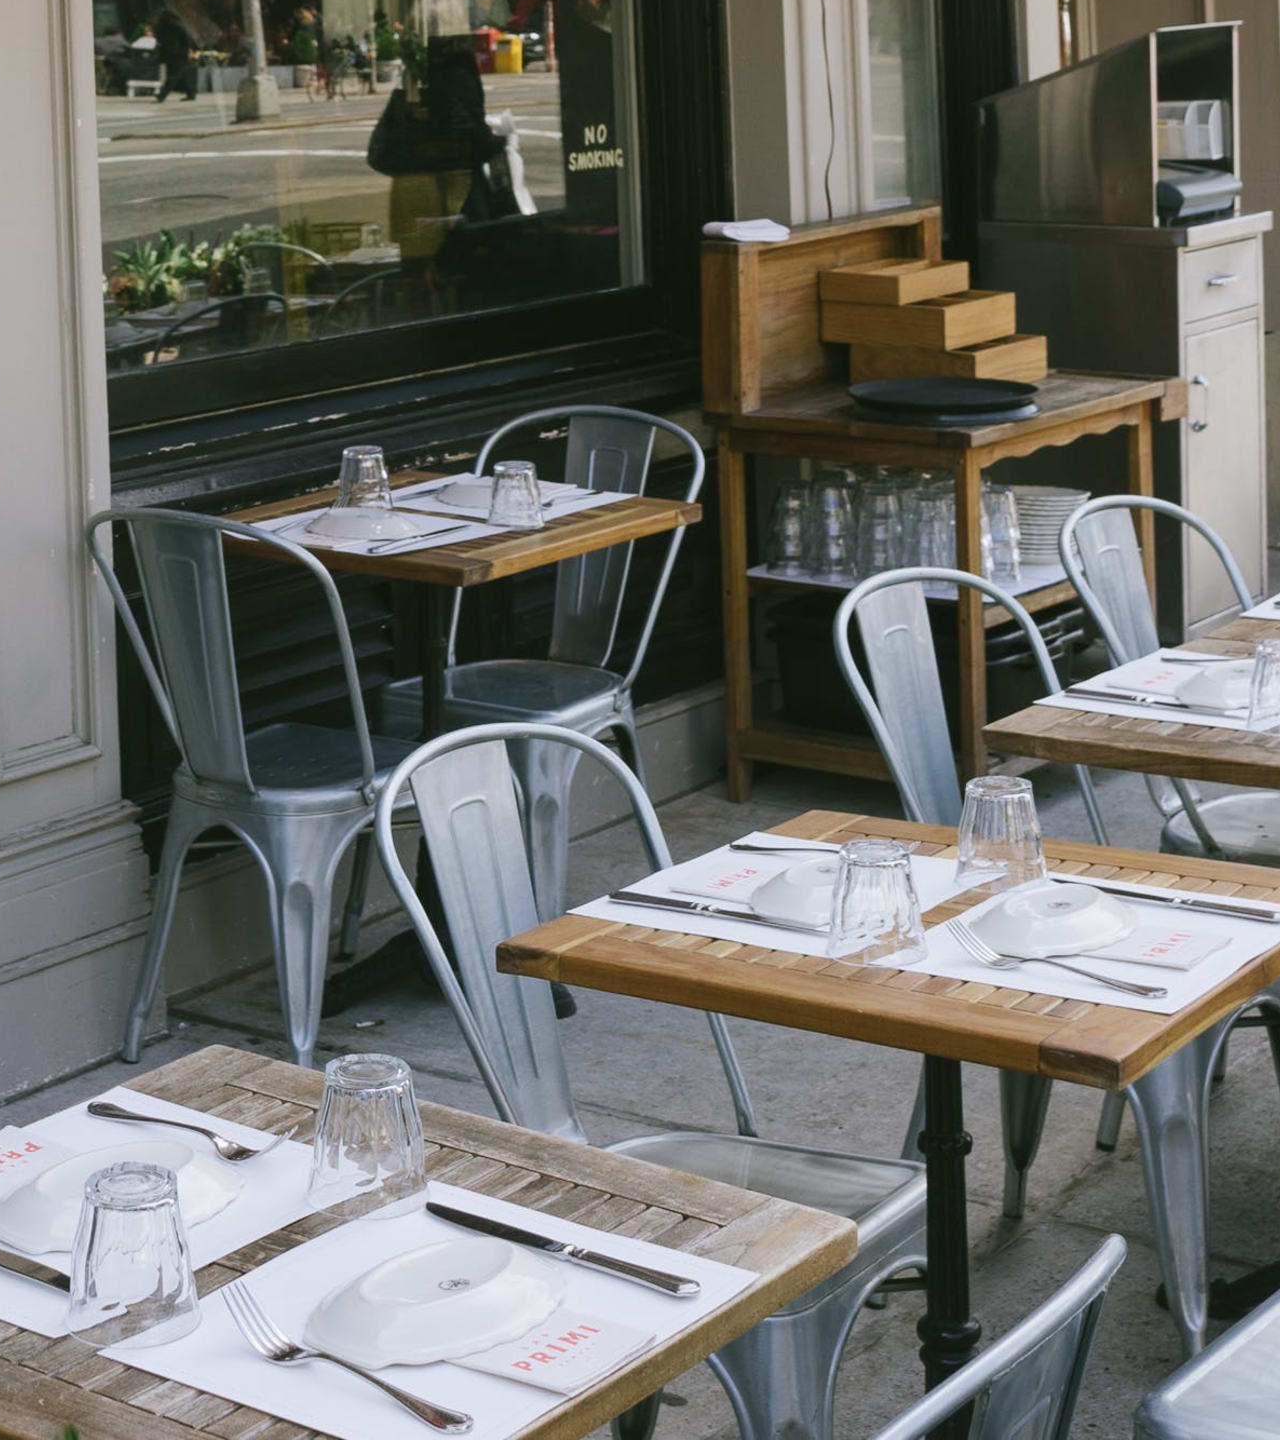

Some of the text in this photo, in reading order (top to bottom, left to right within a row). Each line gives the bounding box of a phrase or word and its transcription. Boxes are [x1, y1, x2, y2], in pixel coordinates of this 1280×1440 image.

[583, 123, 608, 146] NO
[567, 148, 625, 172] SMOKING
[511, 1323, 601, 1372] PRIMI
